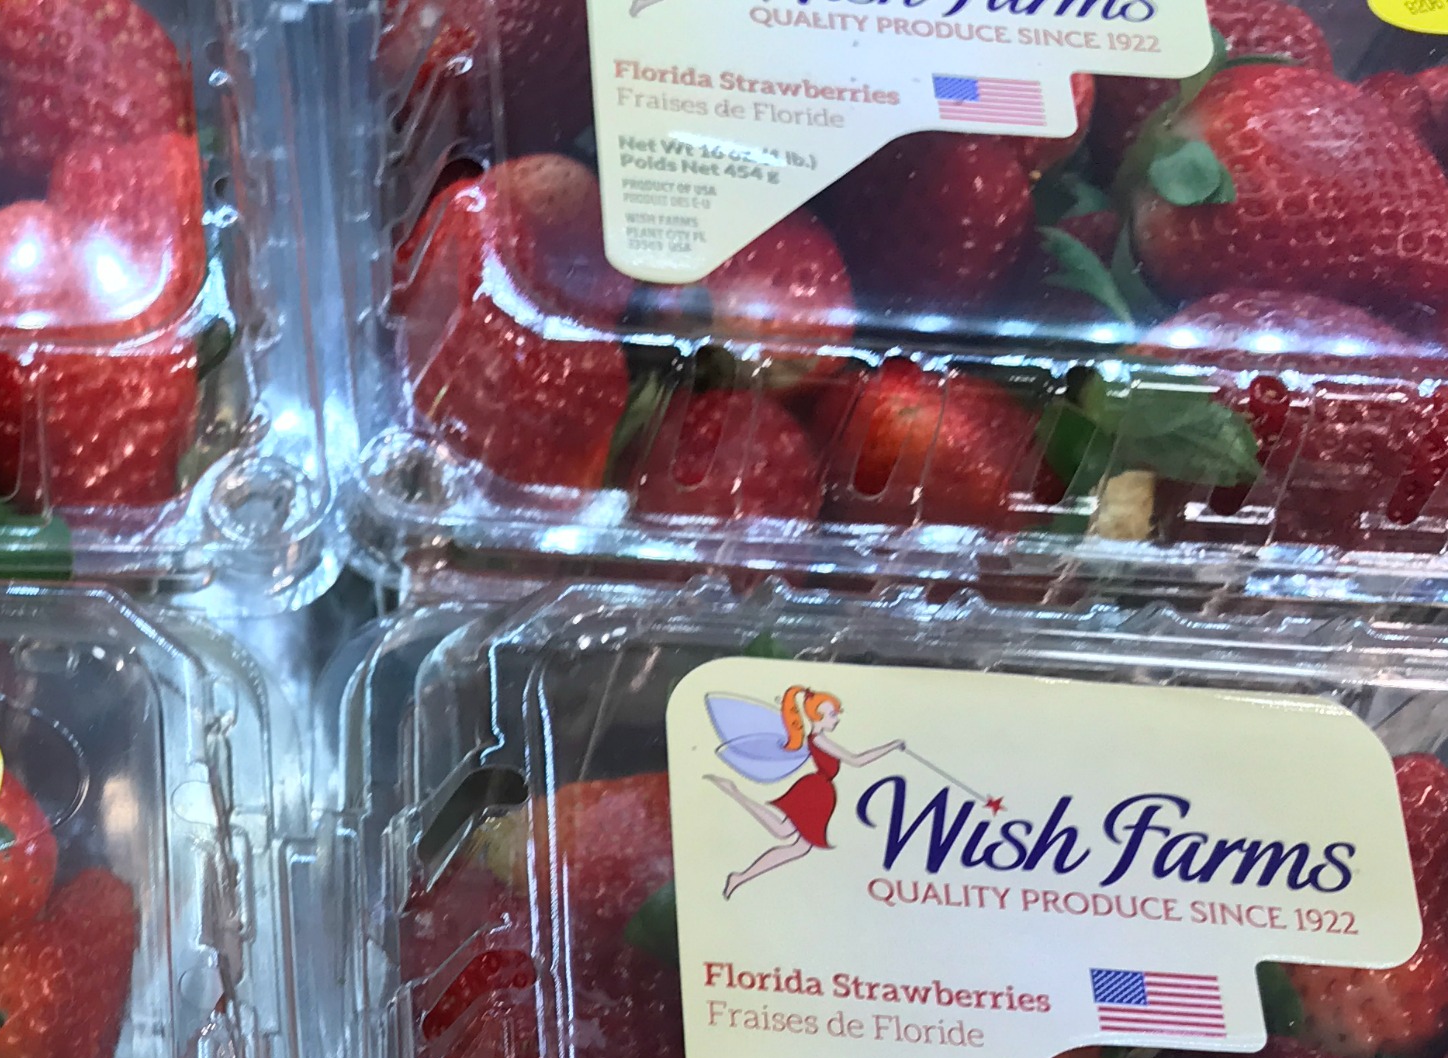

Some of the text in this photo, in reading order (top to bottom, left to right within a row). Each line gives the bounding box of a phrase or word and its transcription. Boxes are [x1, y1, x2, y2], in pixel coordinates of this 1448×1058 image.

[749, 6, 1161, 53] QUALITY PRODUCE SINCE 1922
[614, 59, 900, 106] Florida Strawberries
[617, 87, 845, 128] Fraises de Floride
[619, 135, 656, 152] Net
[620, 153, 677, 172] Poids
[682, 159, 719, 176] Net
[724, 164, 763, 180] 454
[855, 775, 1357, 894] Wish Farms
[866, 877, 1359, 936] QUALITY PRODUCE SINCE 1922
[703, 961, 1052, 1014] Florida Strawberries
[706, 1001, 985, 1048] Fraises de Floride
